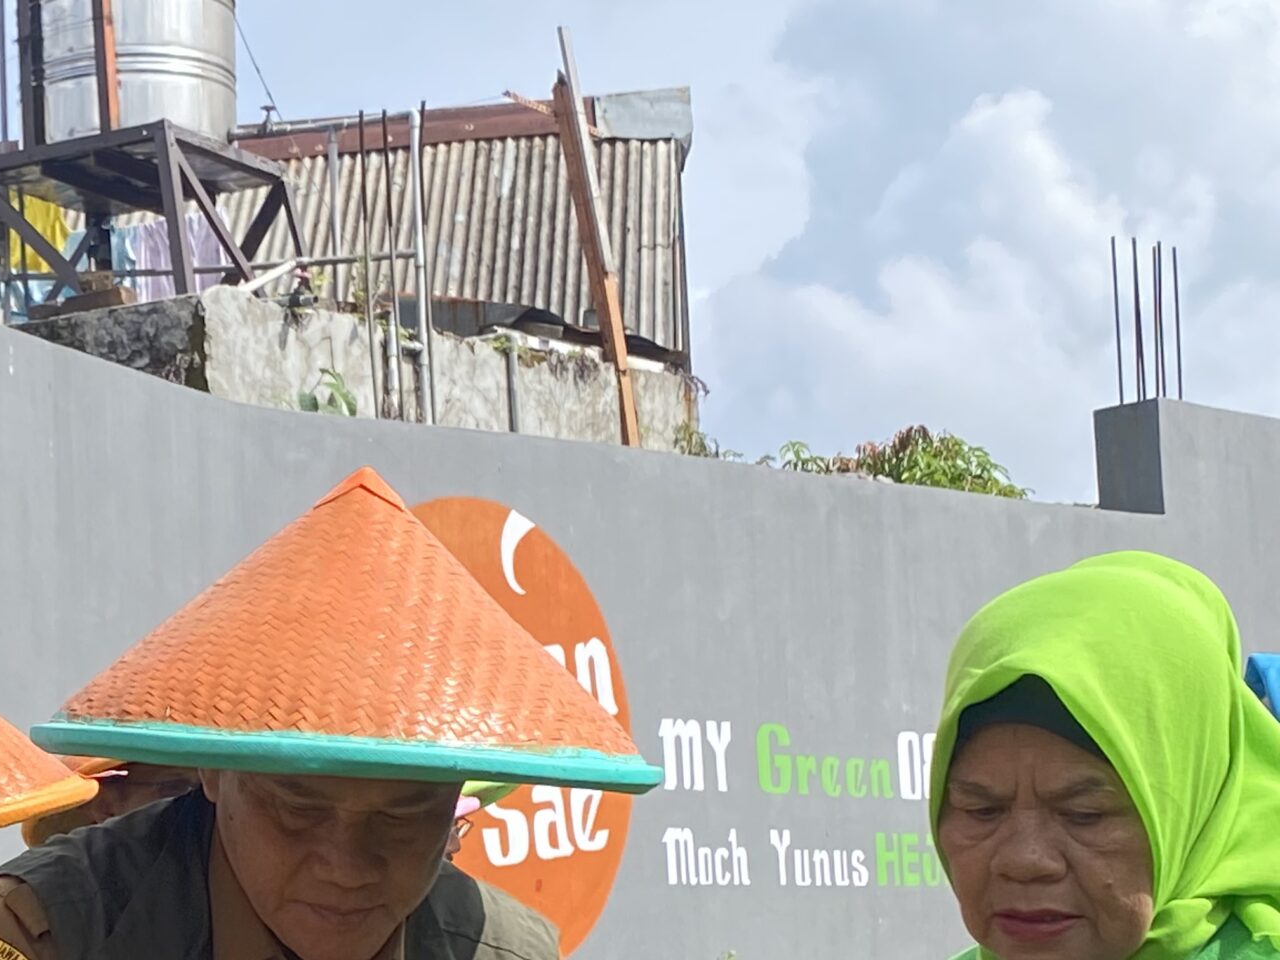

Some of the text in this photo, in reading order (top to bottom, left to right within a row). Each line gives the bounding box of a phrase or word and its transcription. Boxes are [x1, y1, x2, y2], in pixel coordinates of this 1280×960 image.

[658, 718, 732, 792] MY
[662, 827, 751, 886] Moch
[770, 828, 869, 887] Yunus
